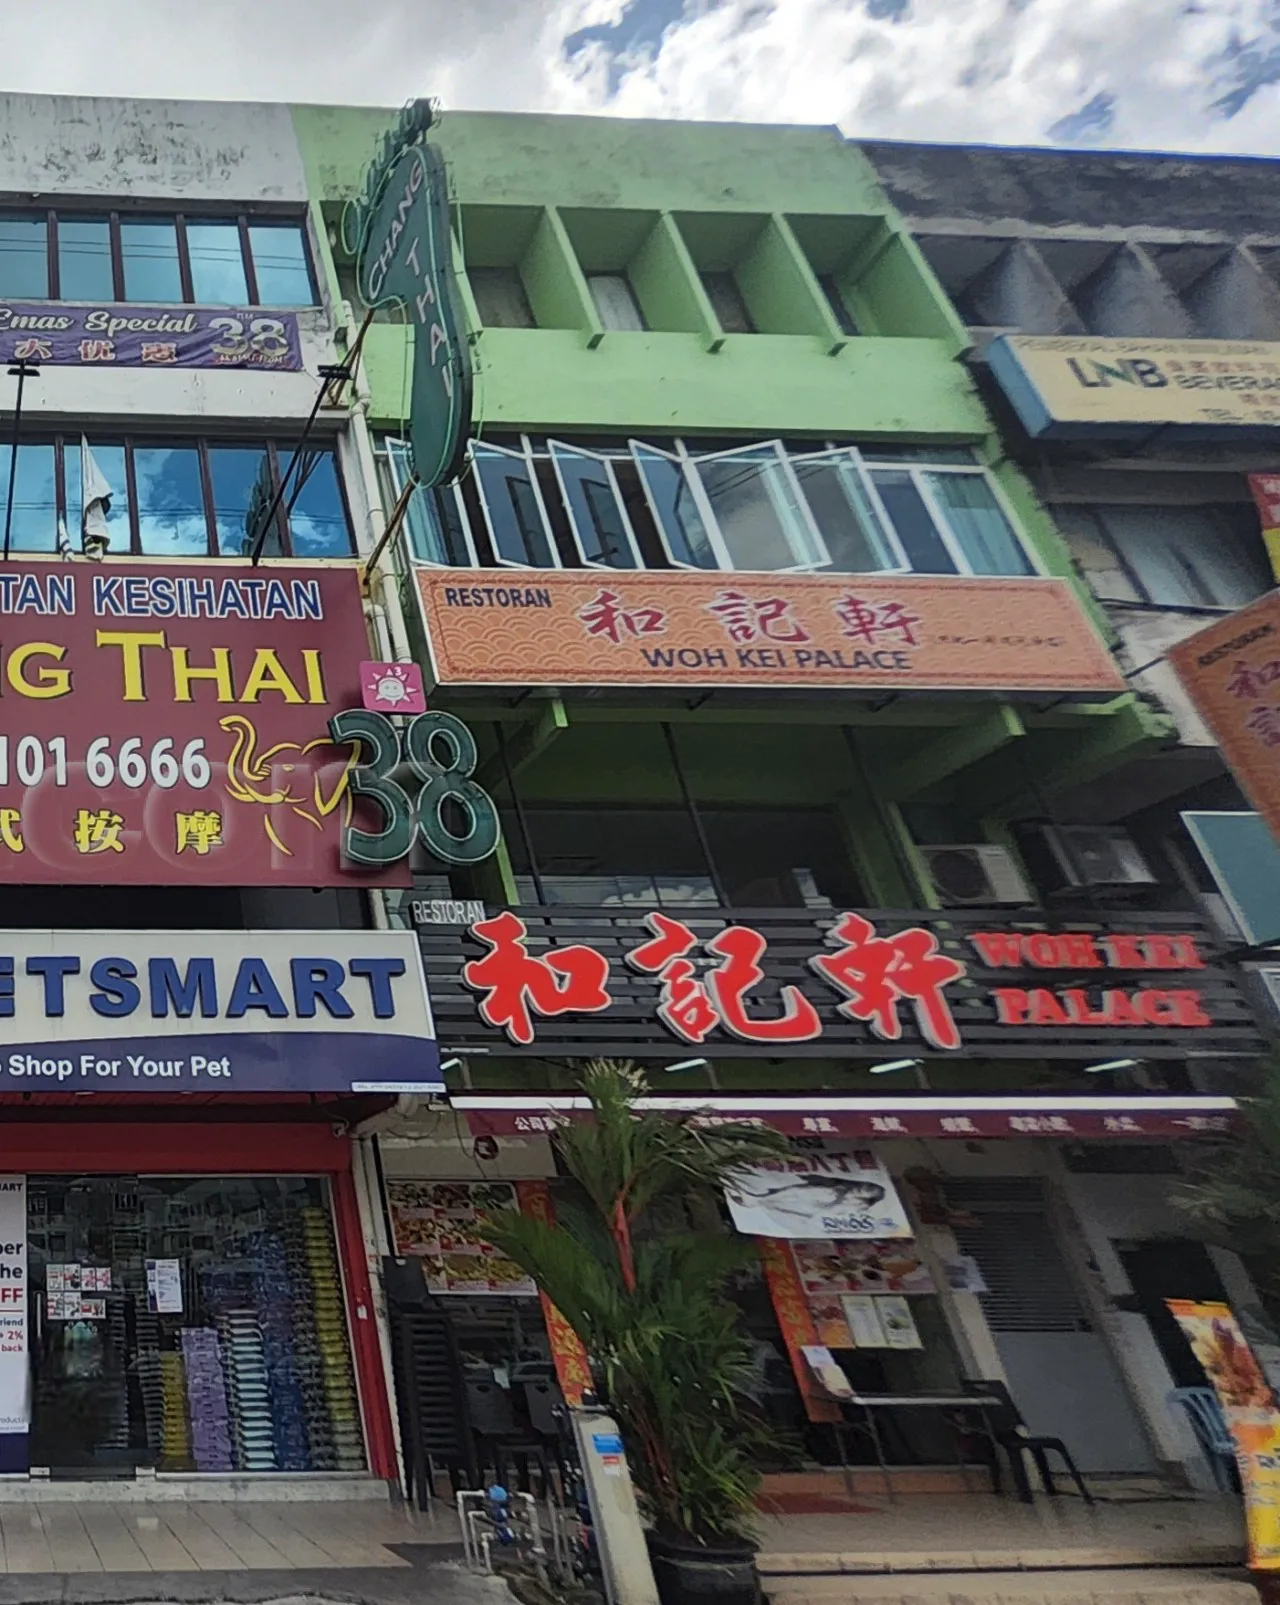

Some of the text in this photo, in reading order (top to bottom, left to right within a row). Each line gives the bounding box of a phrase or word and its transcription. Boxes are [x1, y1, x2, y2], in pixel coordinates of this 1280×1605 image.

[368, 157, 424, 300] CHANG
[84, 310, 198, 337] Special
[208, 316, 290, 357] 38
[1065, 356, 1169, 389] LNB
[93, 576, 323, 620] KESIHATAN
[444, 587, 552, 608] RESTORAN
[579, 587, 924, 647] 和記軒
[640, 648, 914, 669] WOH KEI PALACE
[86, 736, 211, 789] 6666
[328, 709, 502, 867] 38
[412, 900, 485, 925] RESTORAN
[970, 932, 1208, 969] WOH KEI
[462, 911, 965, 1049] 和記軒
[990, 987, 1212, 1026] PALACE
[8, 1054, 73, 1081] Shop
[80, 1055, 120, 1077] For
[126, 1055, 184, 1078] Your
[191, 1055, 231, 1078] Pet
[1, 1344, 23, 1353] back
[7, 1331, 23, 1341] 2%
